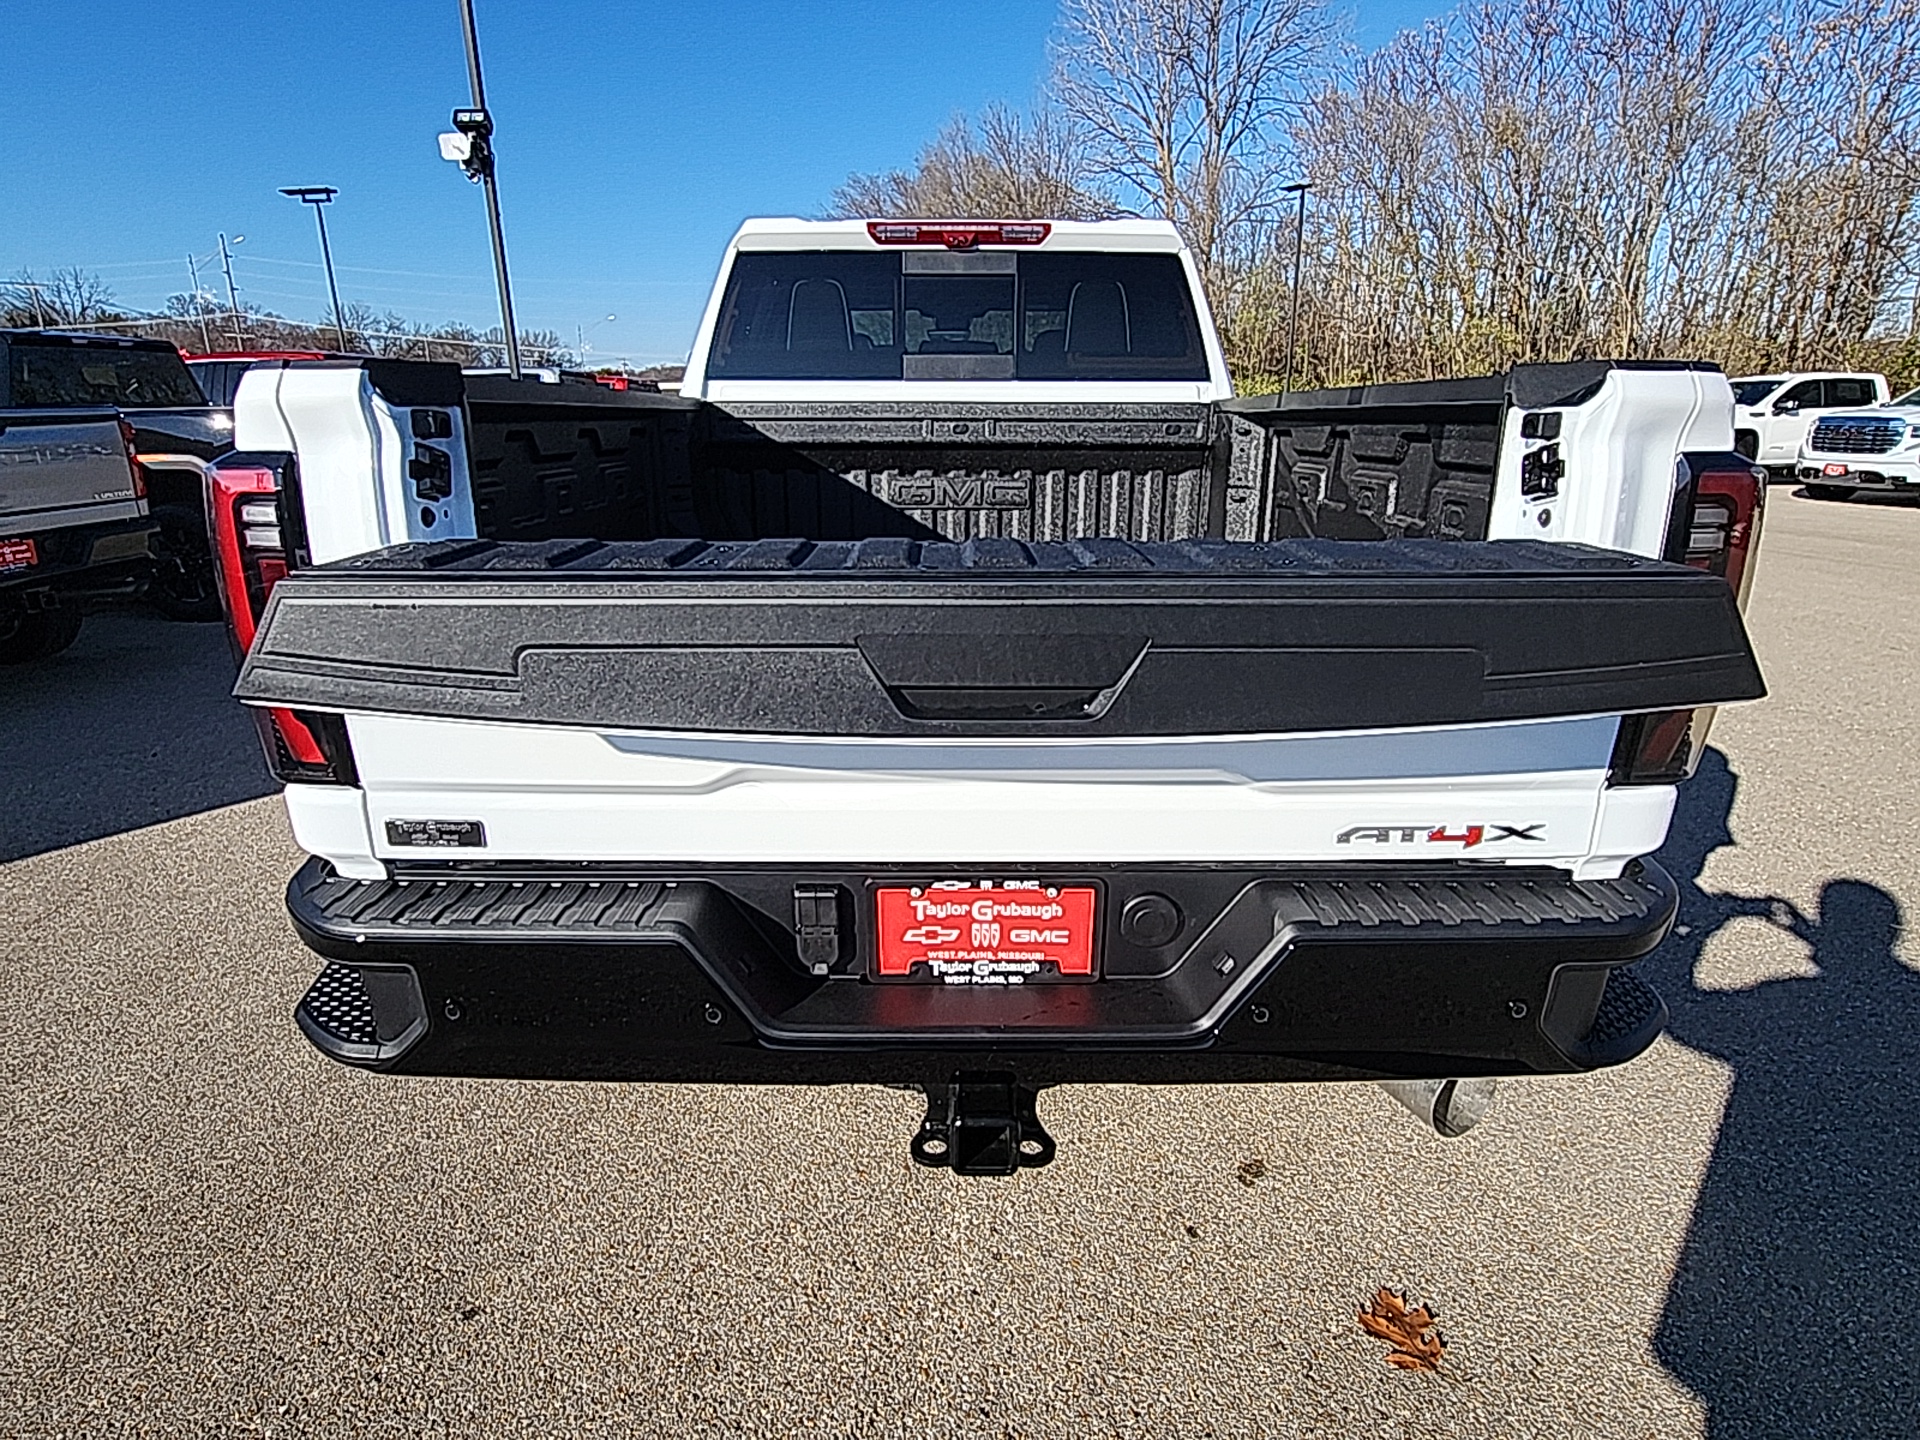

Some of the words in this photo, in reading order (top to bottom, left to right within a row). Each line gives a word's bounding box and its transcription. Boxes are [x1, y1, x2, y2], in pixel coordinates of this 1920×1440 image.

[889, 478, 1029, 507] GMC
[1336, 824, 1546, 849] AT4X
[1003, 880, 1040, 890] GMC
[910, 900, 970, 921] Taylor
[971, 900, 1063, 921] Grubaugh
[1010, 929, 1070, 943] GMC
[927, 951, 956, 959] WEST
[997, 951, 1045, 960] MISSOURI
[928, 960, 972, 976] Taylor
[973, 960, 1040, 976] Grubaugh
[944, 975, 971, 984] WEST
[1008, 975, 1024, 984] MO
